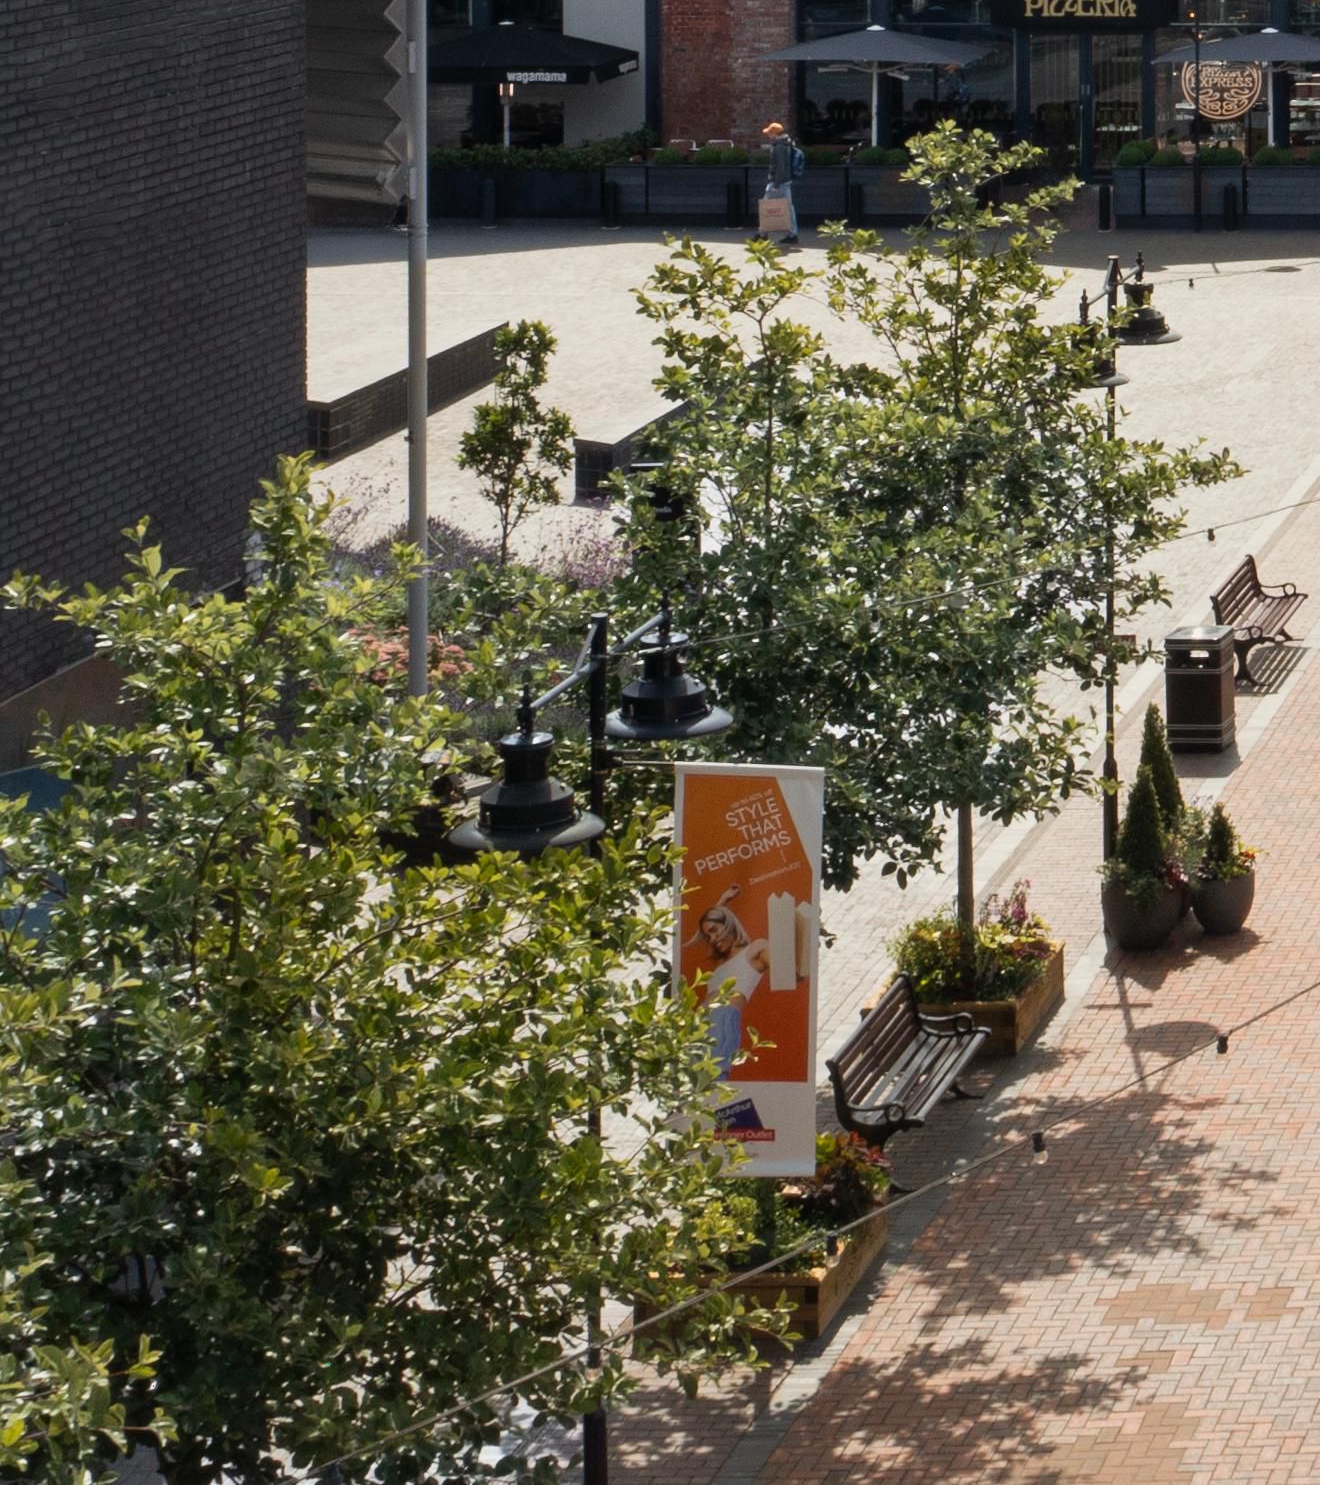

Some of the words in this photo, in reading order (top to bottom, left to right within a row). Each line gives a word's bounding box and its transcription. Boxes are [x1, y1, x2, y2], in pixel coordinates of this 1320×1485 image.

[506, 72, 567, 84] wagamama
[724, 796, 779, 827] STYLE
[737, 813, 784, 840] THAT
[694, 830, 792, 875] PERFORMS
[746, 1129, 773, 1139] Outlet
